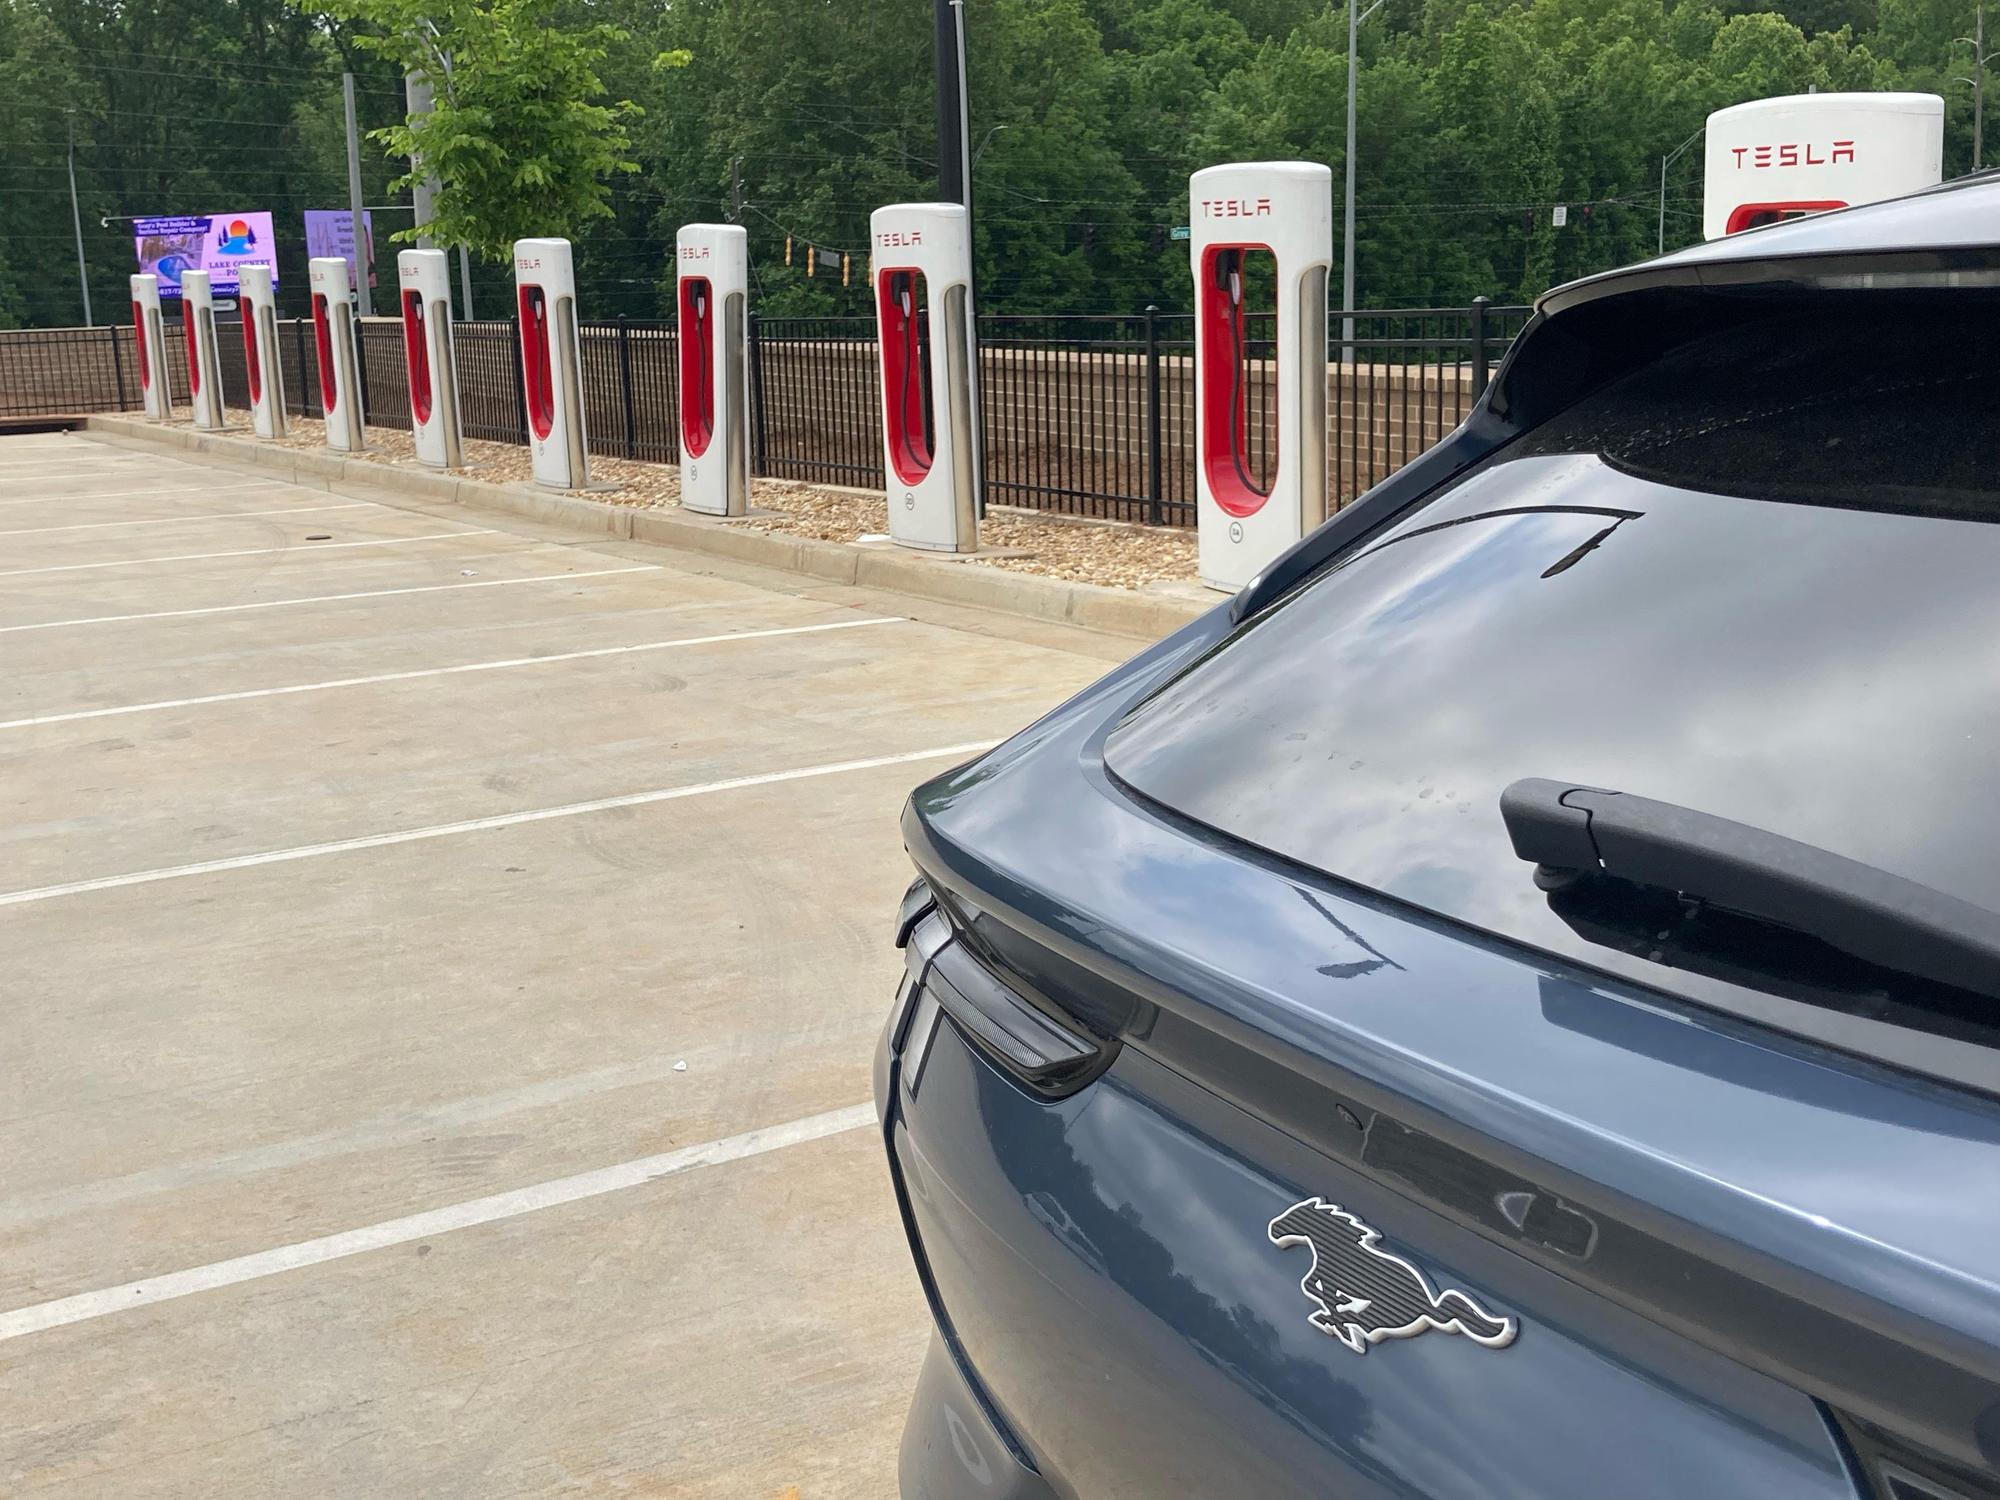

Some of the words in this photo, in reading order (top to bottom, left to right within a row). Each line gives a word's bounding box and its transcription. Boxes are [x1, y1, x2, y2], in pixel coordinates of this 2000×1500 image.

[1732, 140, 1854, 169] TESLA
[1202, 199, 1271, 218] TESLA
[876, 232, 921, 247] TESLA
[209, 261, 231, 269] LAKE
